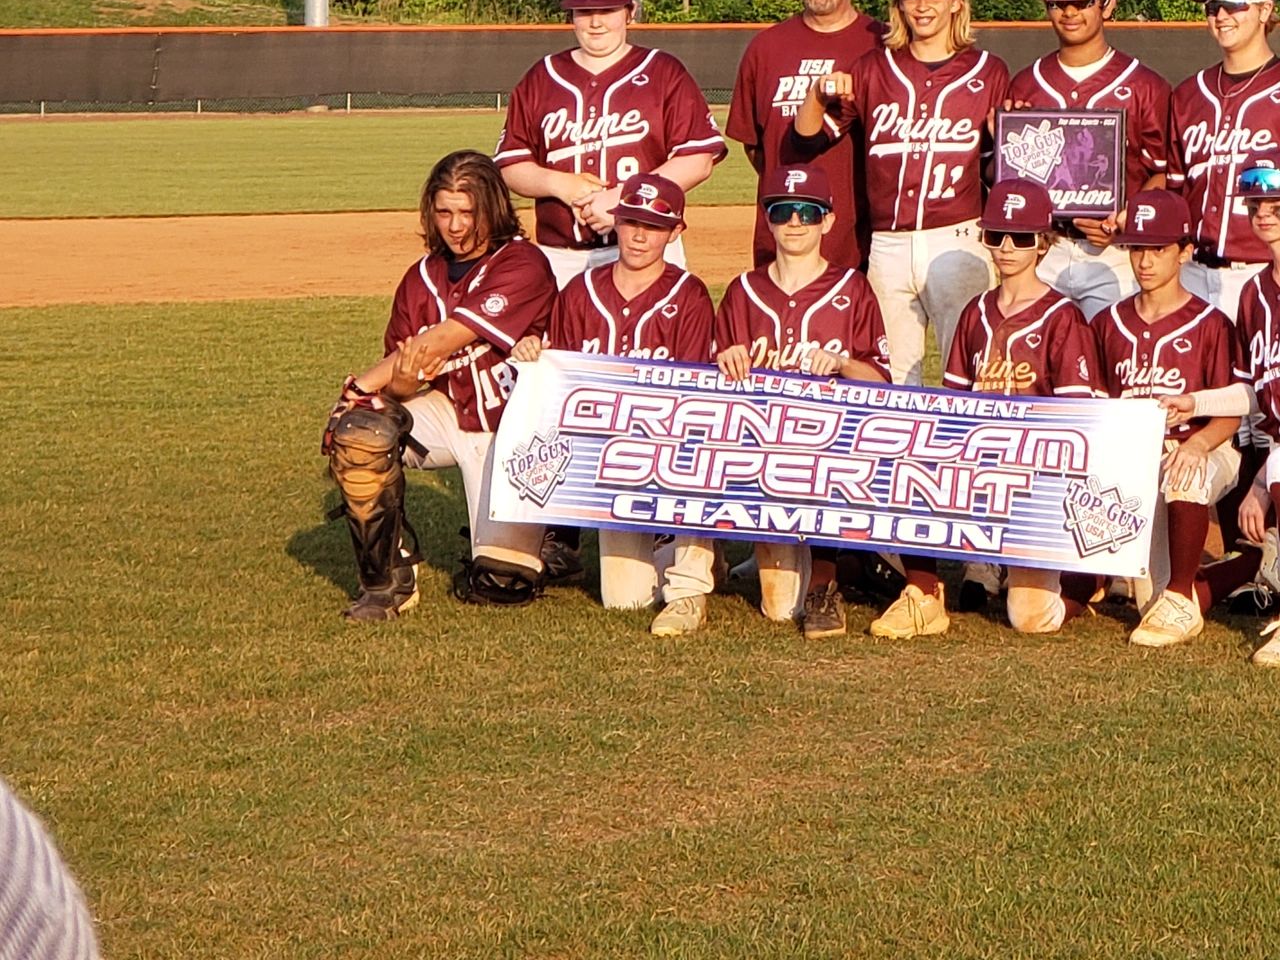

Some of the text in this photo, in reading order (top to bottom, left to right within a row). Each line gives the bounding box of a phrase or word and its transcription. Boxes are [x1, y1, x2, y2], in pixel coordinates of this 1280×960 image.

[798, 59, 836, 75] USA
[541, 107, 649, 150] Prime
[869, 102, 979, 142] Prime
[1183, 121, 1278, 164] Prime
[632, 364, 688, 387] TOP
[703, 370, 756, 392] GUN
[763, 375, 823, 401] USA
[831, 385, 1032, 420] TOURNAMENT
[558, 387, 1089, 472] GRAND SLAM
[507, 439, 570, 477] TOP GUN
[531, 473, 549, 486] USA
[599, 436, 1034, 515] SUPER NIT
[611, 493, 1005, 551] CHAMPION
[1070, 482, 1144, 534] TOP GUN
[1081, 510, 1118, 534] SPORTS
[1085, 523, 1105, 540] USA
